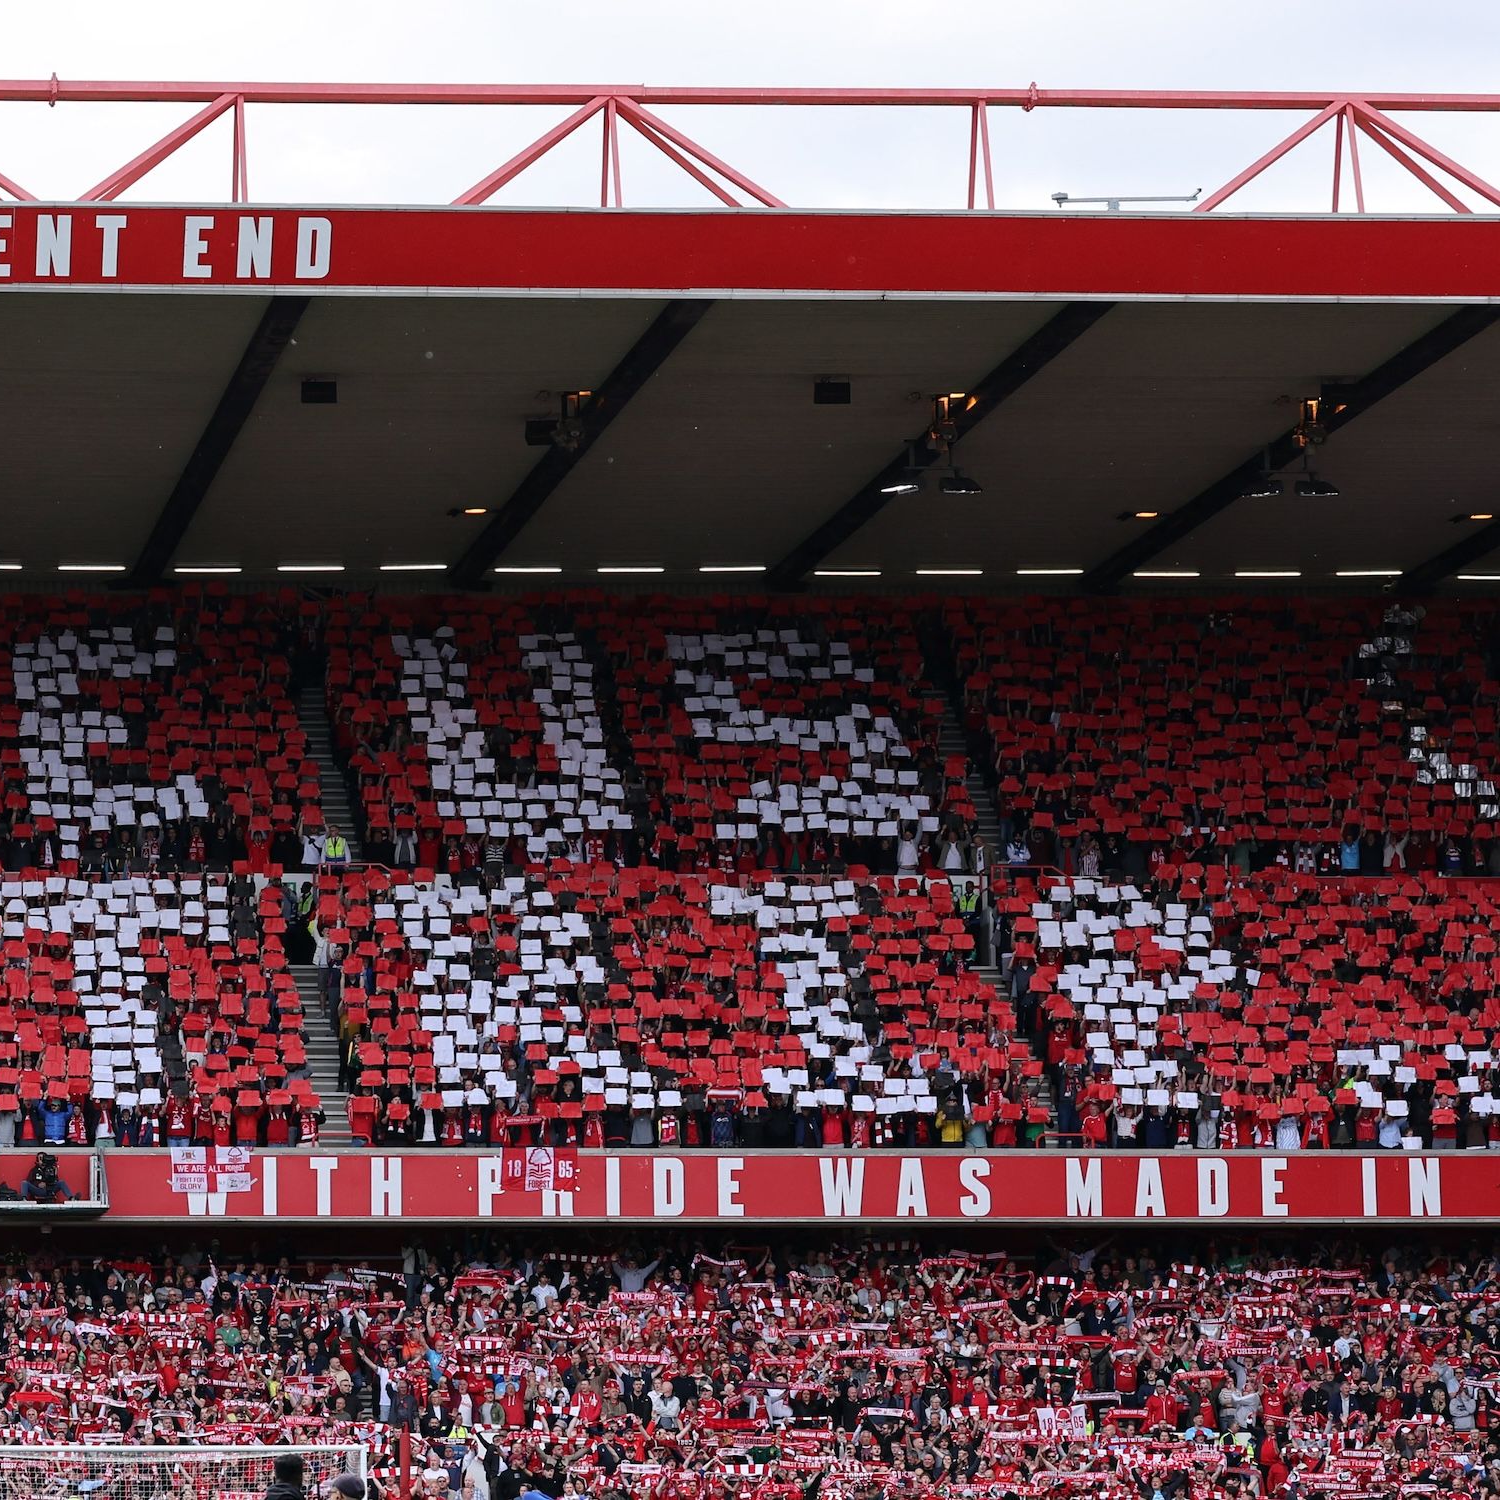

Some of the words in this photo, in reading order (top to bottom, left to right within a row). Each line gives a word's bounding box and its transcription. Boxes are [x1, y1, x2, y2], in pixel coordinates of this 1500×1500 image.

[182, 216, 333, 279] END
[176, 1164, 189, 1173] WE
[191, 1164, 206, 1173] ARE
[208, 1164, 222, 1173] ALL
[225, 1164, 245, 1173] FOREST
[507, 1160, 522, 1177] 18
[558, 1160, 573, 1178] 65
[528, 1180, 550, 1188] FOREST
[819, 1157, 993, 1217] WAS
[1066, 1158, 1288, 1217] MADE
[1361, 1158, 1441, 1217] IN
[1136, 1316, 1174, 1328] NFFC
[1042, 1417, 1053, 1430] 18
[1074, 1415, 1084, 1429] 65
